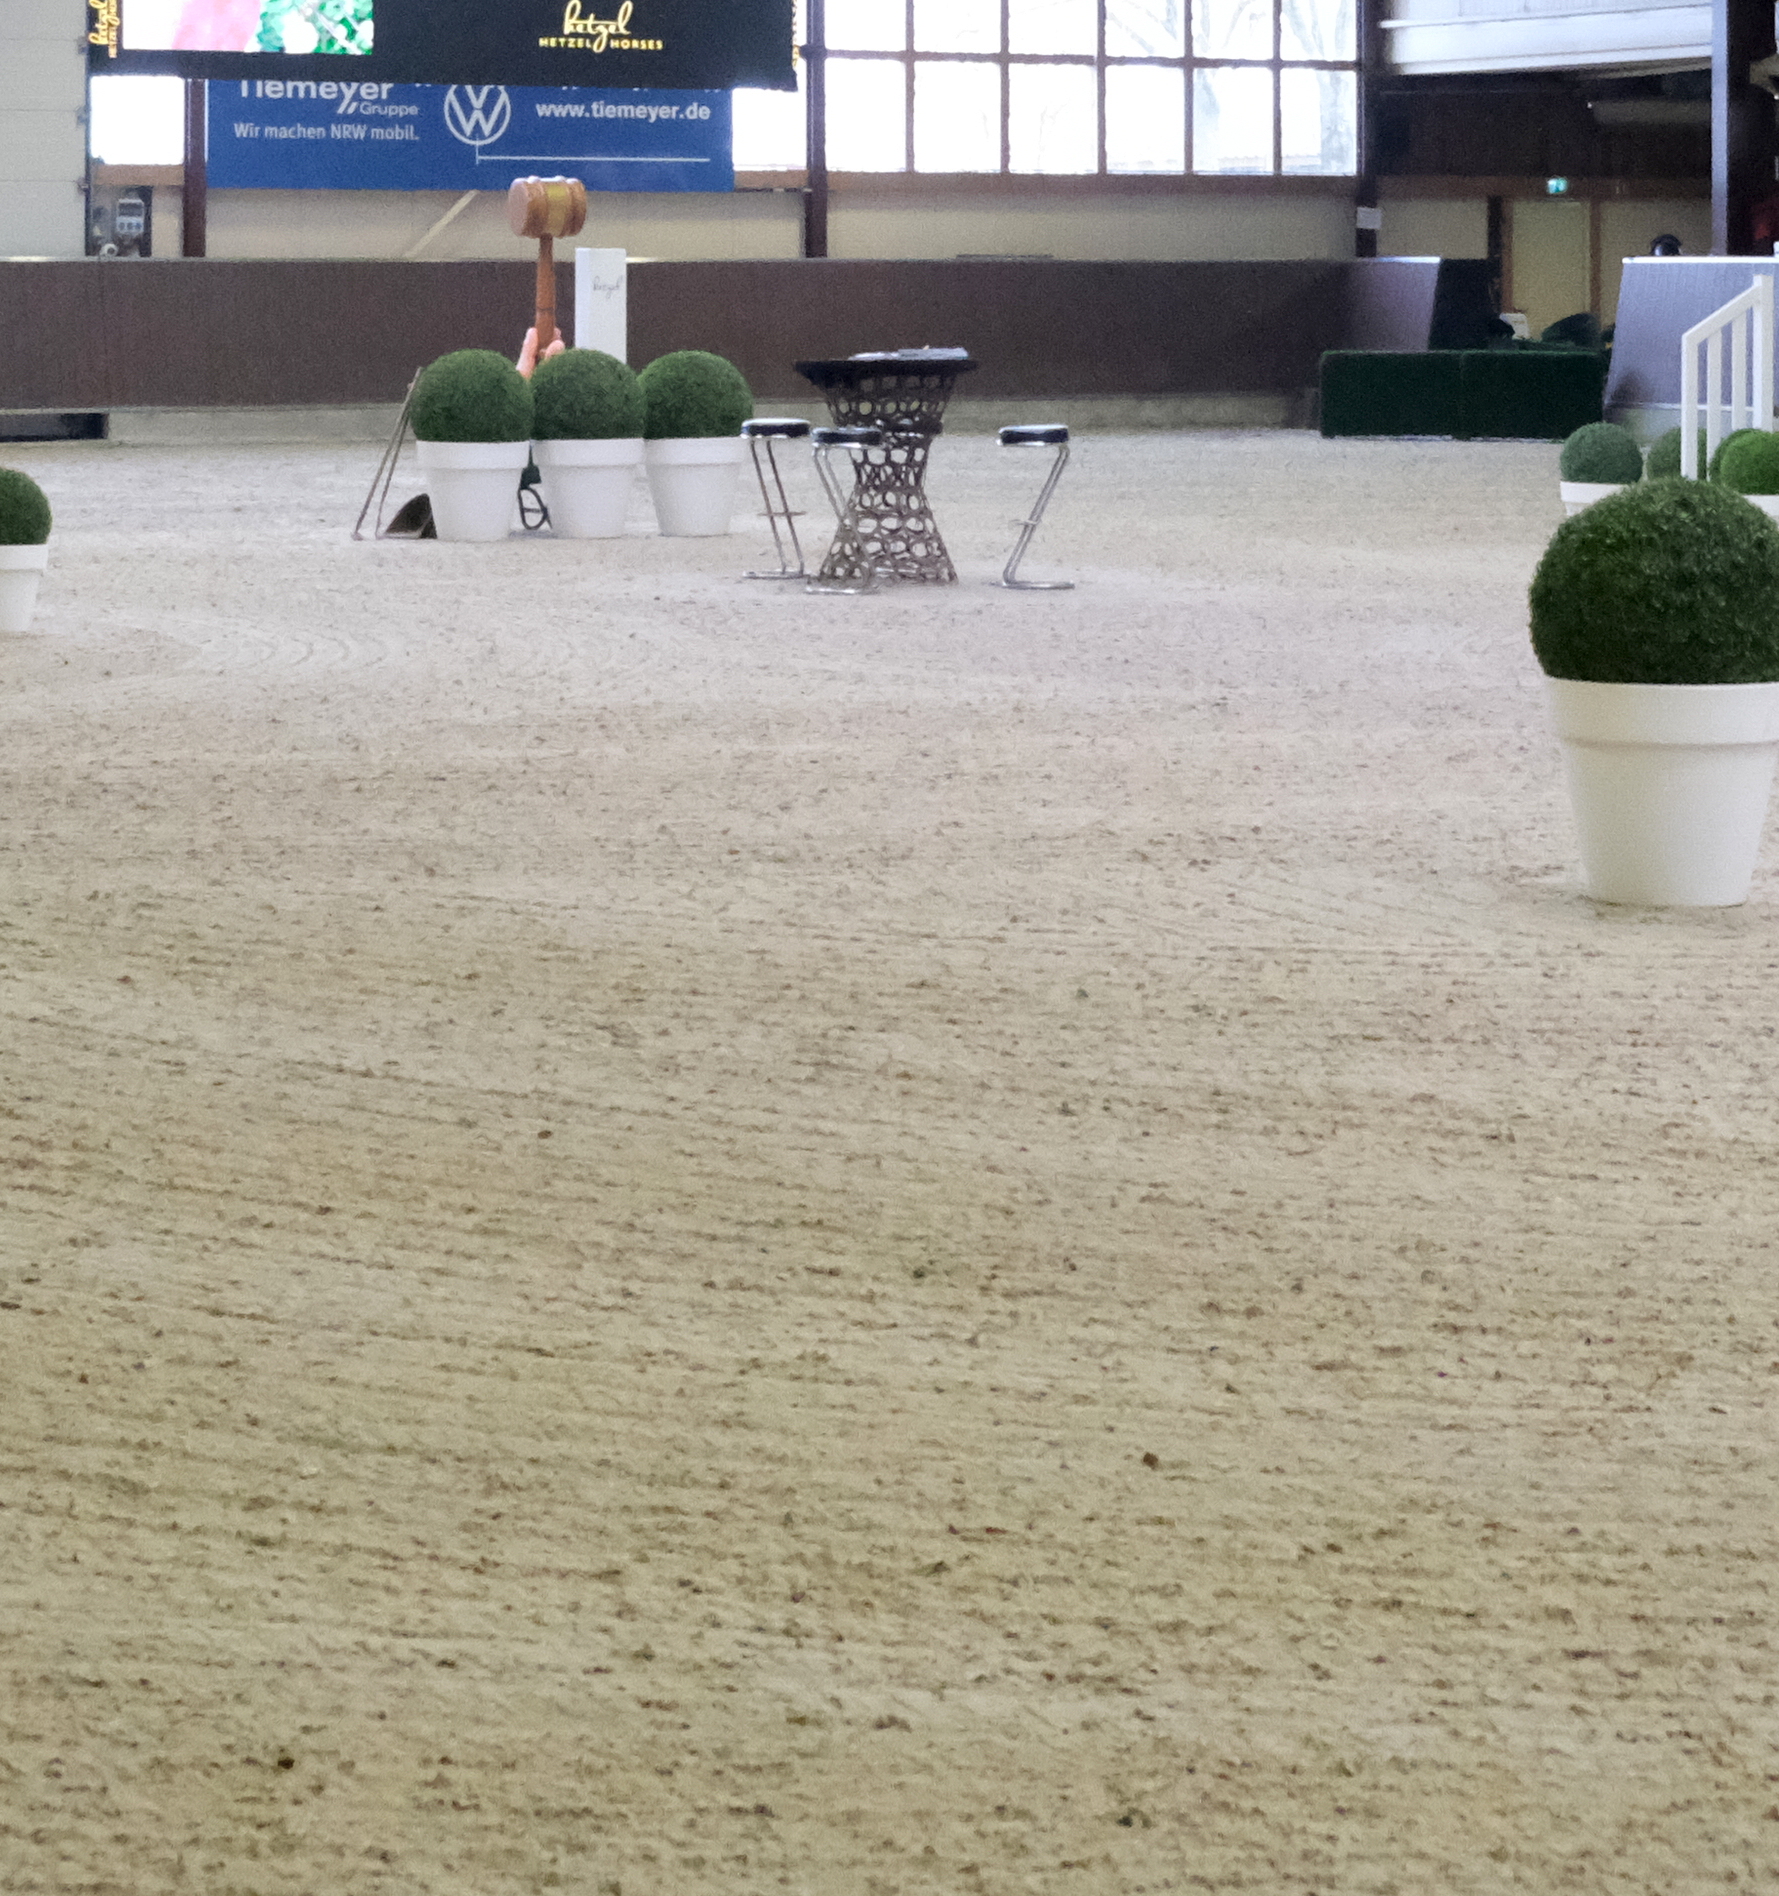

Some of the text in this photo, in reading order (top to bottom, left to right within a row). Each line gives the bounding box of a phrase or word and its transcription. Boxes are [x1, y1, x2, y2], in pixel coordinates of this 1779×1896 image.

[538, 37, 664, 50] HETZEL HORSES
[360, 102, 419, 117] Gruppe
[536, 100, 711, 123] www.tiemeyer.de
[234, 122, 420, 140] Wir machen NRW mobil.
